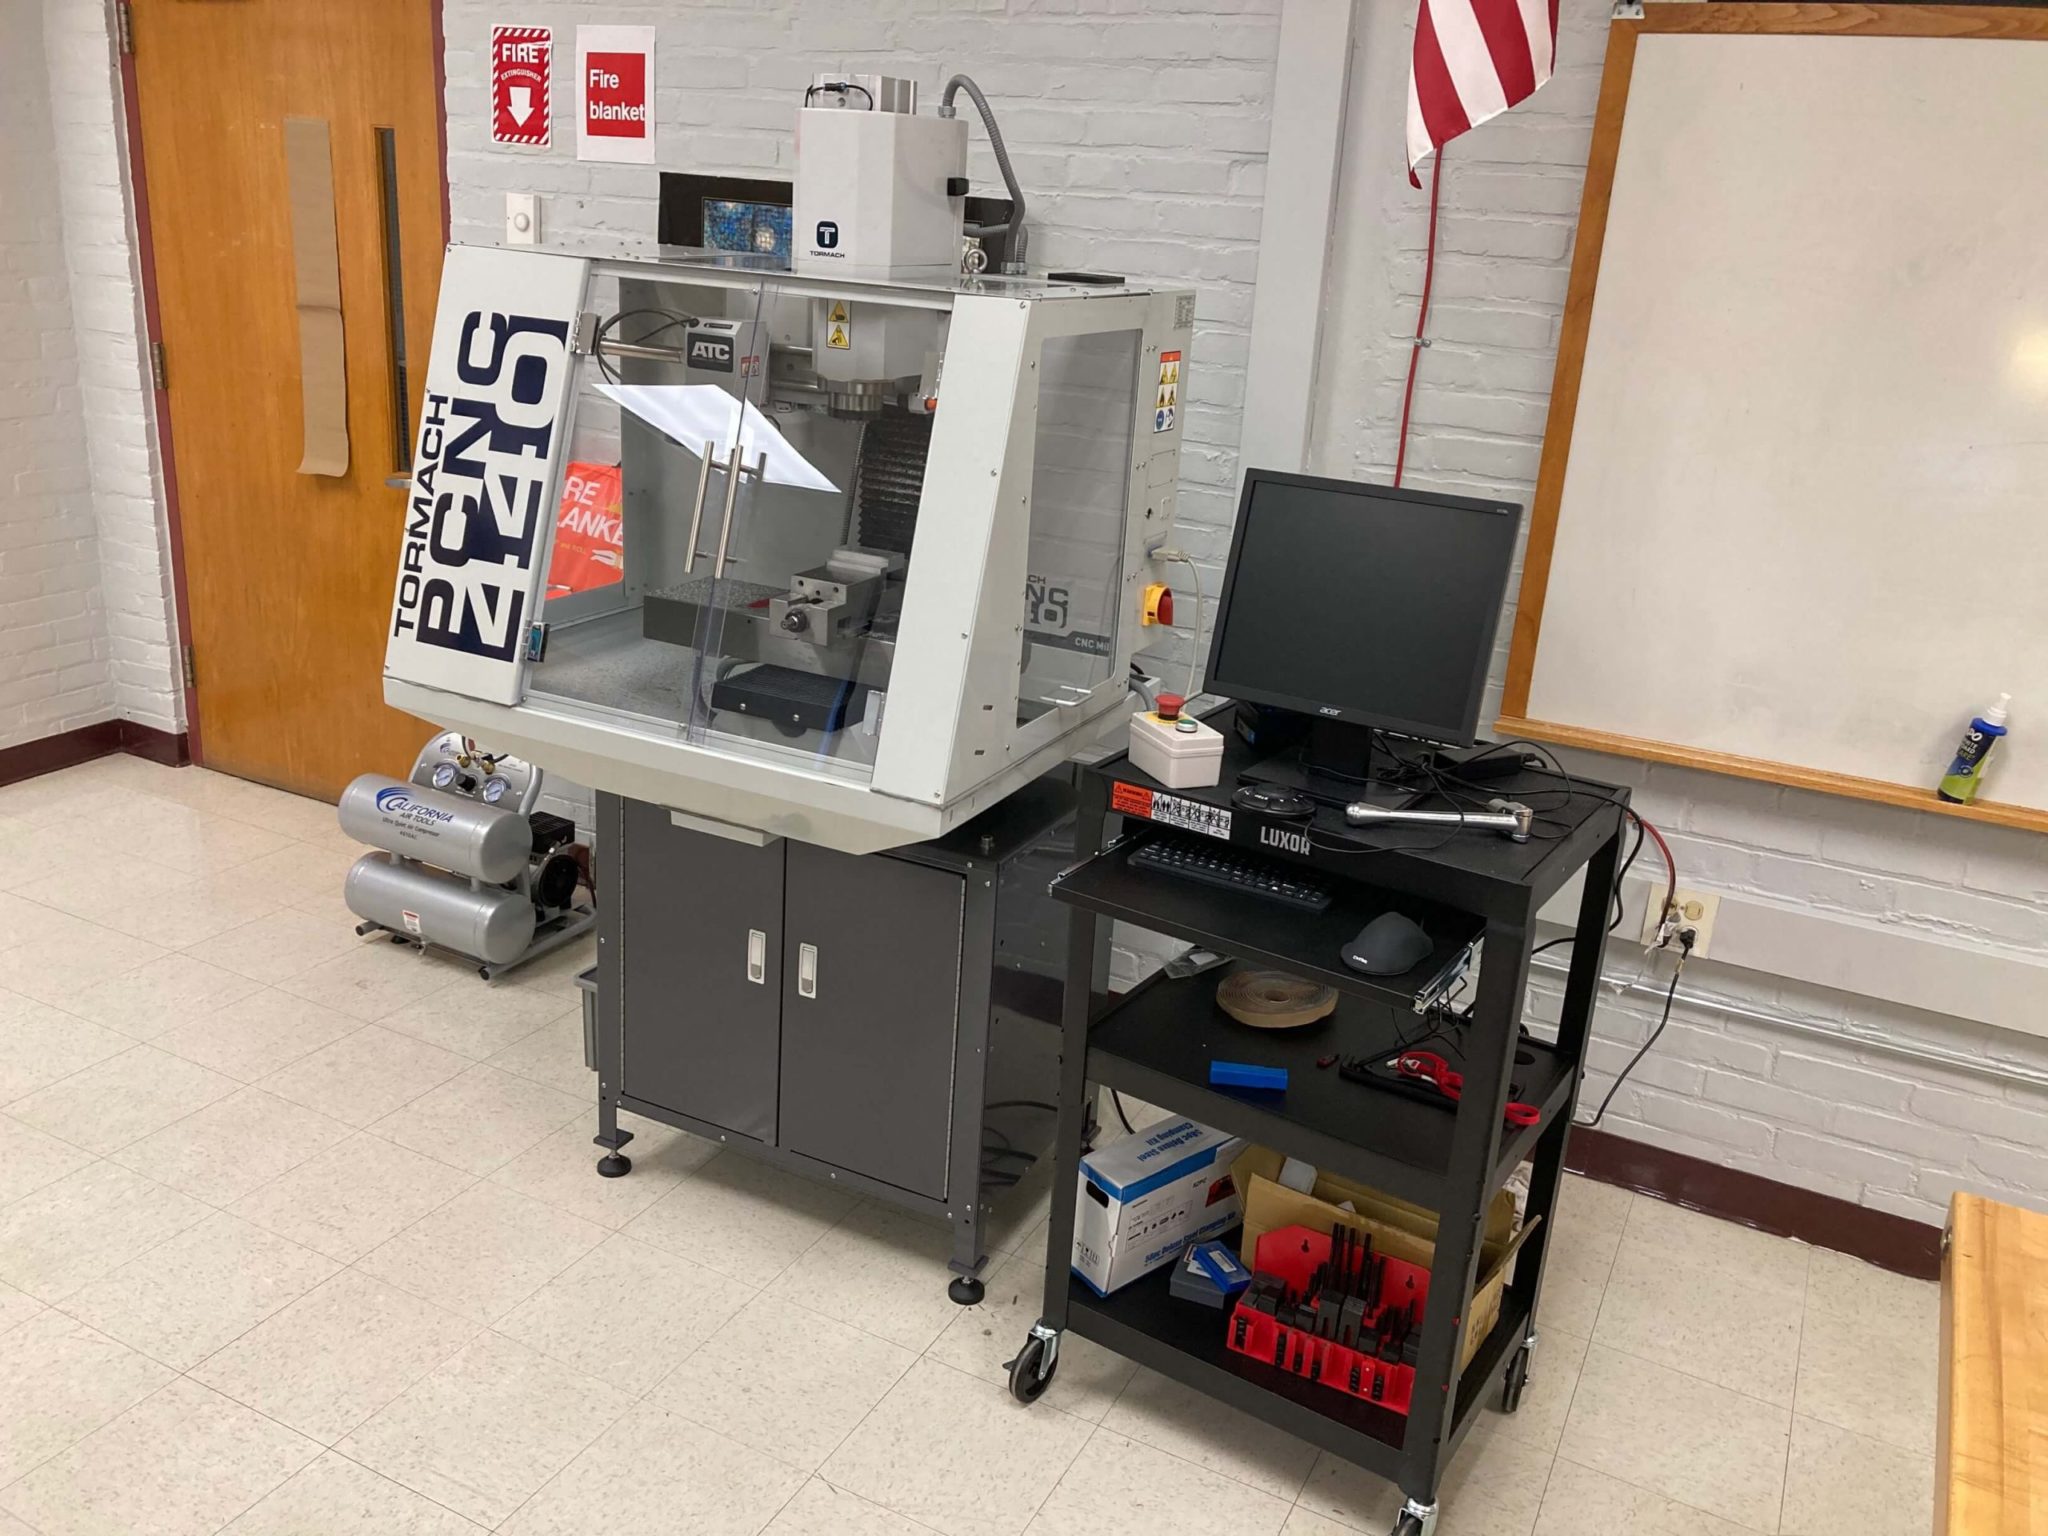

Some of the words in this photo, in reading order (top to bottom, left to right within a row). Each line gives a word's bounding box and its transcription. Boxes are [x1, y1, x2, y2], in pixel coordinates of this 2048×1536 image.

[502, 43, 539, 63] FIRE
[501, 68, 542, 83] EXTINGUISHER
[590, 69, 619, 89] Fire
[590, 101, 645, 121] blanket
[809, 250, 845, 259] TORMACH
[691, 341, 730, 361] ATC
[416, 311, 507, 650] PCNC
[394, 394, 448, 637] TORMACH
[1075, 637, 1095, 649] CNC
[1320, 706, 1342, 716] acer
[386, 797, 455, 823] CALIFORNIA
[400, 812, 413, 821] AIR
[414, 815, 437, 826] TOOLS
[1260, 826, 1311, 856] LUXOR
